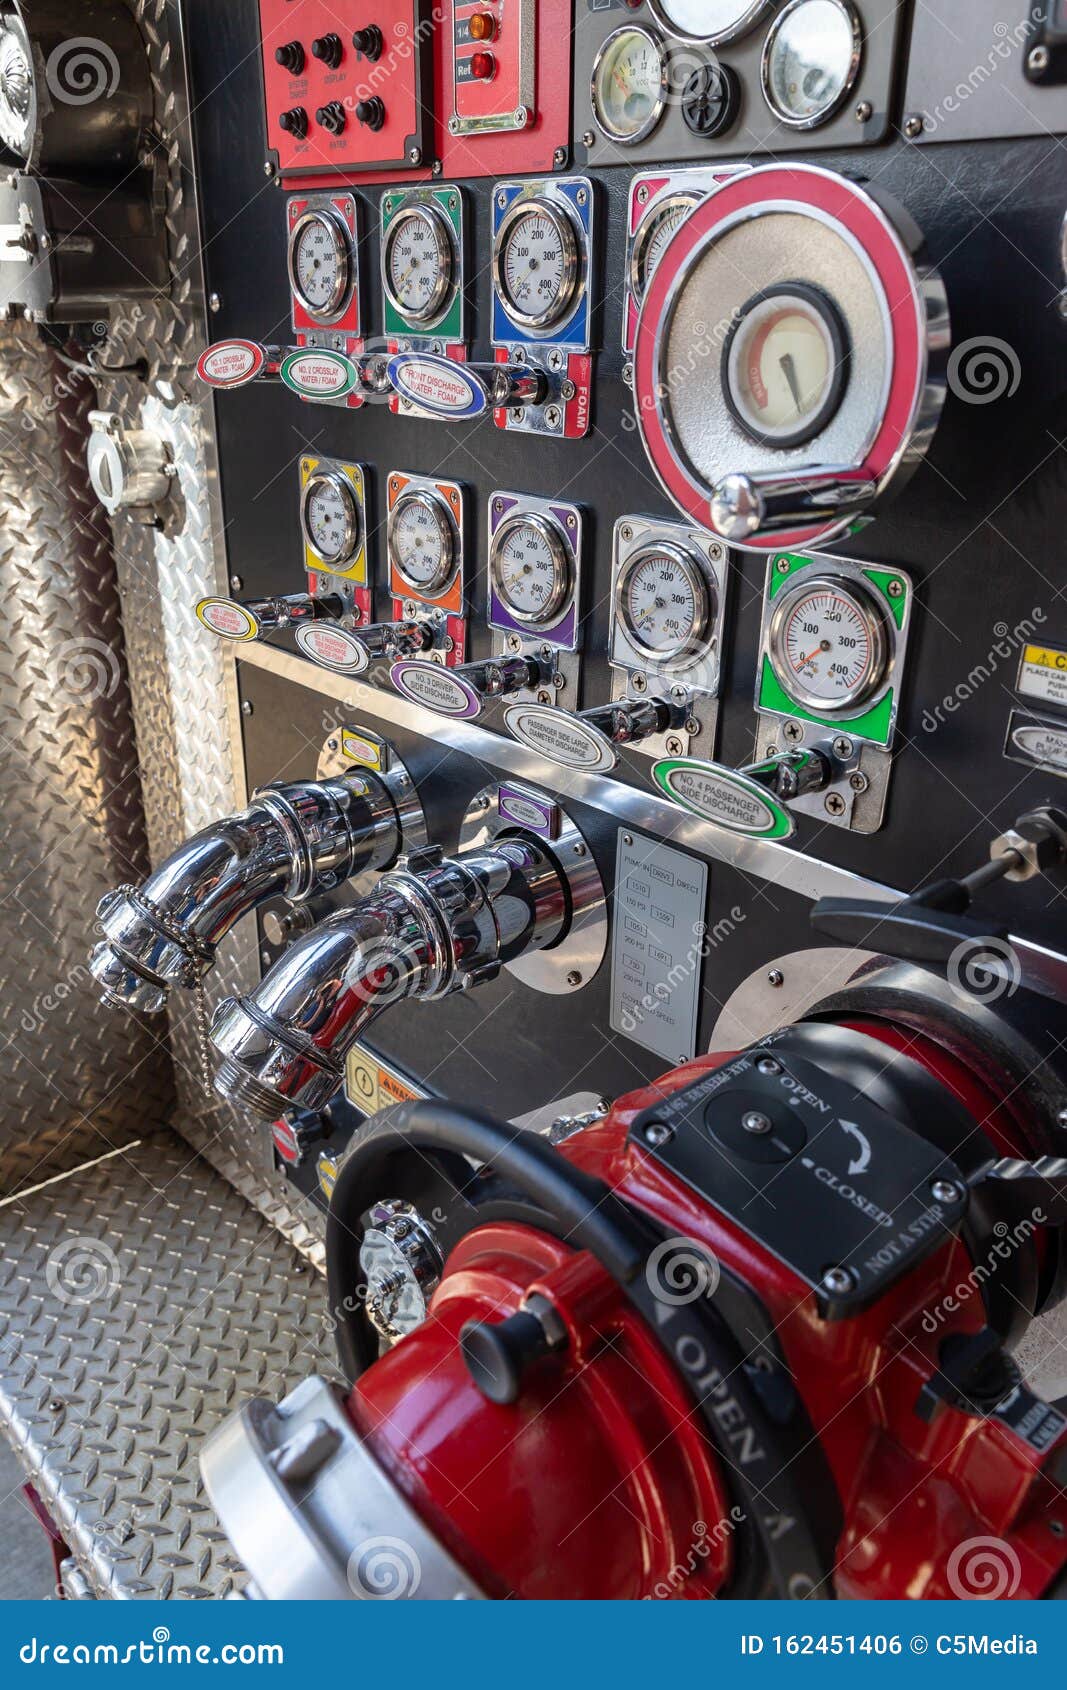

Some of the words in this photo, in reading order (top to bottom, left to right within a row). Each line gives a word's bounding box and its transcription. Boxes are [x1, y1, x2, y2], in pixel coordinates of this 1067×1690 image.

[413, 231, 424, 241] 200
[531, 230, 544, 240] 200
[401, 247, 411, 256] 100
[422, 252, 433, 261] 300
[517, 247, 529, 257] 100
[543, 251, 556, 261] 300
[418, 277, 430, 286] 400
[539, 279, 552, 289] 400
[405, 368, 427, 380] FRONT
[427, 374, 466, 396] DISCHARGE
[437, 390, 457, 404] FOAM
[577, 386, 588, 429] FOAM
[526, 540, 538, 550] 200
[512, 550, 524, 560] 100
[535, 560, 548, 571] 300
[659, 570, 674, 582] 200
[531, 583, 544, 594] 400
[642, 582, 657, 593] 100
[671, 593, 686, 605] 300
[823, 609, 842, 623] 200
[664, 618, 679, 630] 400
[802, 622, 819, 635] 100
[838, 635, 857, 649] 300
[830, 663, 849, 676] 400
[1026, 666, 1049, 678] PLACE
[431, 679, 454, 693] DRIVER
[410, 680, 424, 693] SIDE
[424, 686, 460, 706] DISCHARGE
[528, 719, 558, 738] PASSENGER
[558, 731, 570, 742] SIDE
[571, 736, 589, 751] LARGE
[529, 728, 555, 745] DIAMETER
[556, 741, 587, 758] DISCHARGE
[680, 773, 696, 786] NO.
[705, 784, 760, 814] PASSENGER
[680, 786, 701, 799] SIDE
[703, 795, 756, 824] DISCHARGE
[676, 878, 699, 895] DIRECT
[780, 1076, 832, 1112] OPEN
[813, 1167, 894, 1228] CLOSED
[864, 1241, 901, 1276] NOT
[898, 1232, 916, 1249] A
[908, 1203, 944, 1238] STEP
[675, 1334, 767, 1466] OPEN
